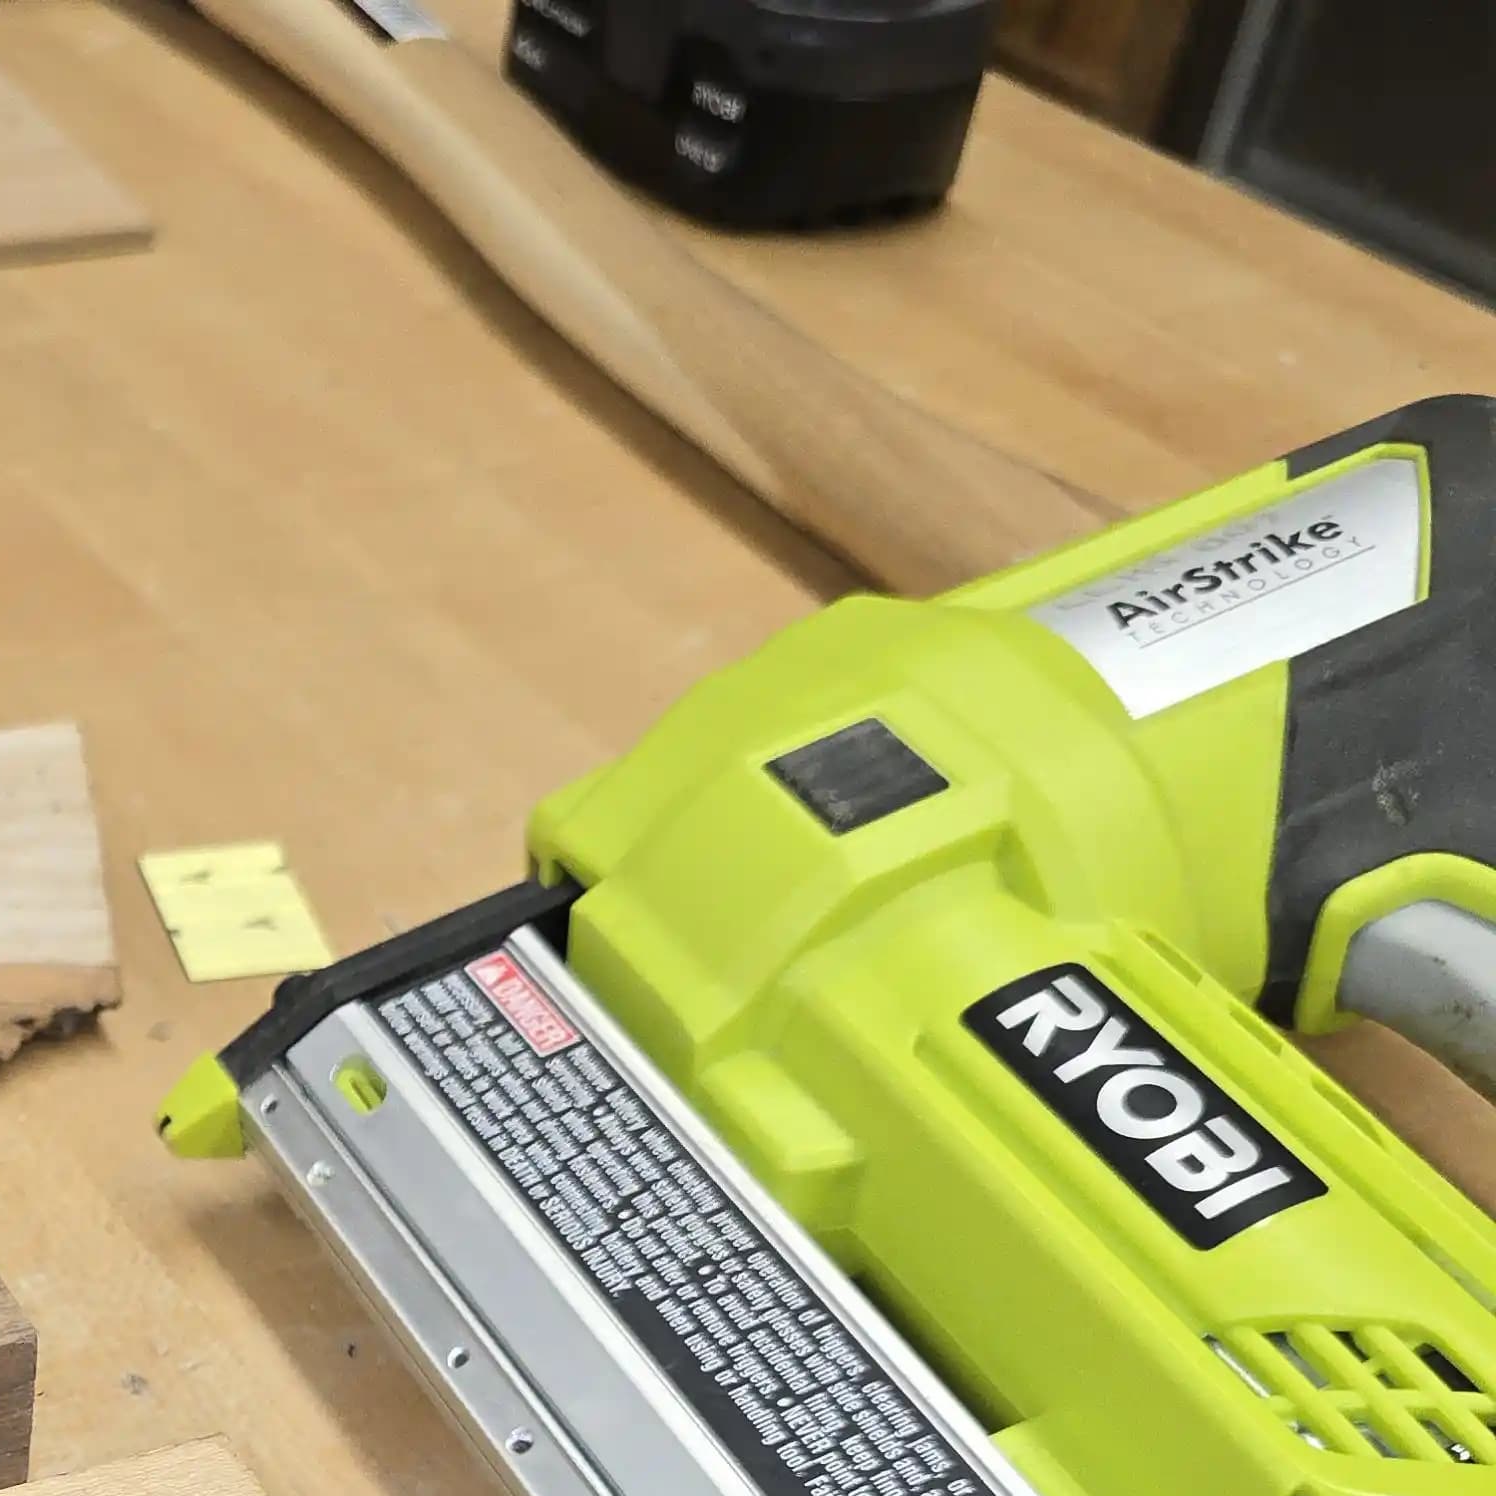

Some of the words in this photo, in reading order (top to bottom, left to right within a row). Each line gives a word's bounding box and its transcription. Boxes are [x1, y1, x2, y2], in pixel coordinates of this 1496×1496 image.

[1106, 520, 1343, 630] AirStrike
[1128, 534, 1360, 644] TECHNOLOGY
[494, 976, 569, 1049] DANGER
[995, 974, 1292, 1219] RYOBI
[620, 1216, 649, 1238] Do
[634, 1235, 666, 1259] not
[676, 1209, 732, 1260] goggles
[580, 1246, 631, 1296] INJURY.
[651, 1255, 688, 1285] alter
[719, 1257, 744, 1276] or
[724, 1268, 774, 1313] safety
[676, 1283, 700, 1300] or
[646, 1214, 703, 1266] product.
[702, 1274, 727, 1294] To
[716, 1293, 762, 1329] avoid
[747, 1329, 817, 1394] accidental
[799, 1392, 847, 1438] firing,
[833, 1433, 881, 1470] keep
[688, 1298, 738, 1345] remove
[758, 1307, 820, 1357] glasses
[595, 1231, 645, 1279] battery
[634, 1274, 669, 1300] and
[656, 1298, 696, 1334] when
[684, 1332, 725, 1371] using
[714, 1369, 740, 1385] or
[728, 1384, 787, 1444] handling
[776, 1441, 814, 1476] tool.
[706, 1210, 758, 1250] proper
[747, 1251, 807, 1309] operation
[797, 1309, 827, 1326] of
[812, 1323, 868, 1381] triggers,
[858, 1381, 921, 1437] clearing
[904, 1434, 953, 1478] jams,
[947, 1478, 975, 1496] or
[727, 1342, 779, 1398] triggers.
[803, 1350, 841, 1384] with
[827, 1380, 864, 1411] side
[780, 1404, 834, 1453] NEVER
[852, 1409, 908, 1459] shields
[812, 1451, 864, 1491] point
[889, 1457, 935, 1491] and,
